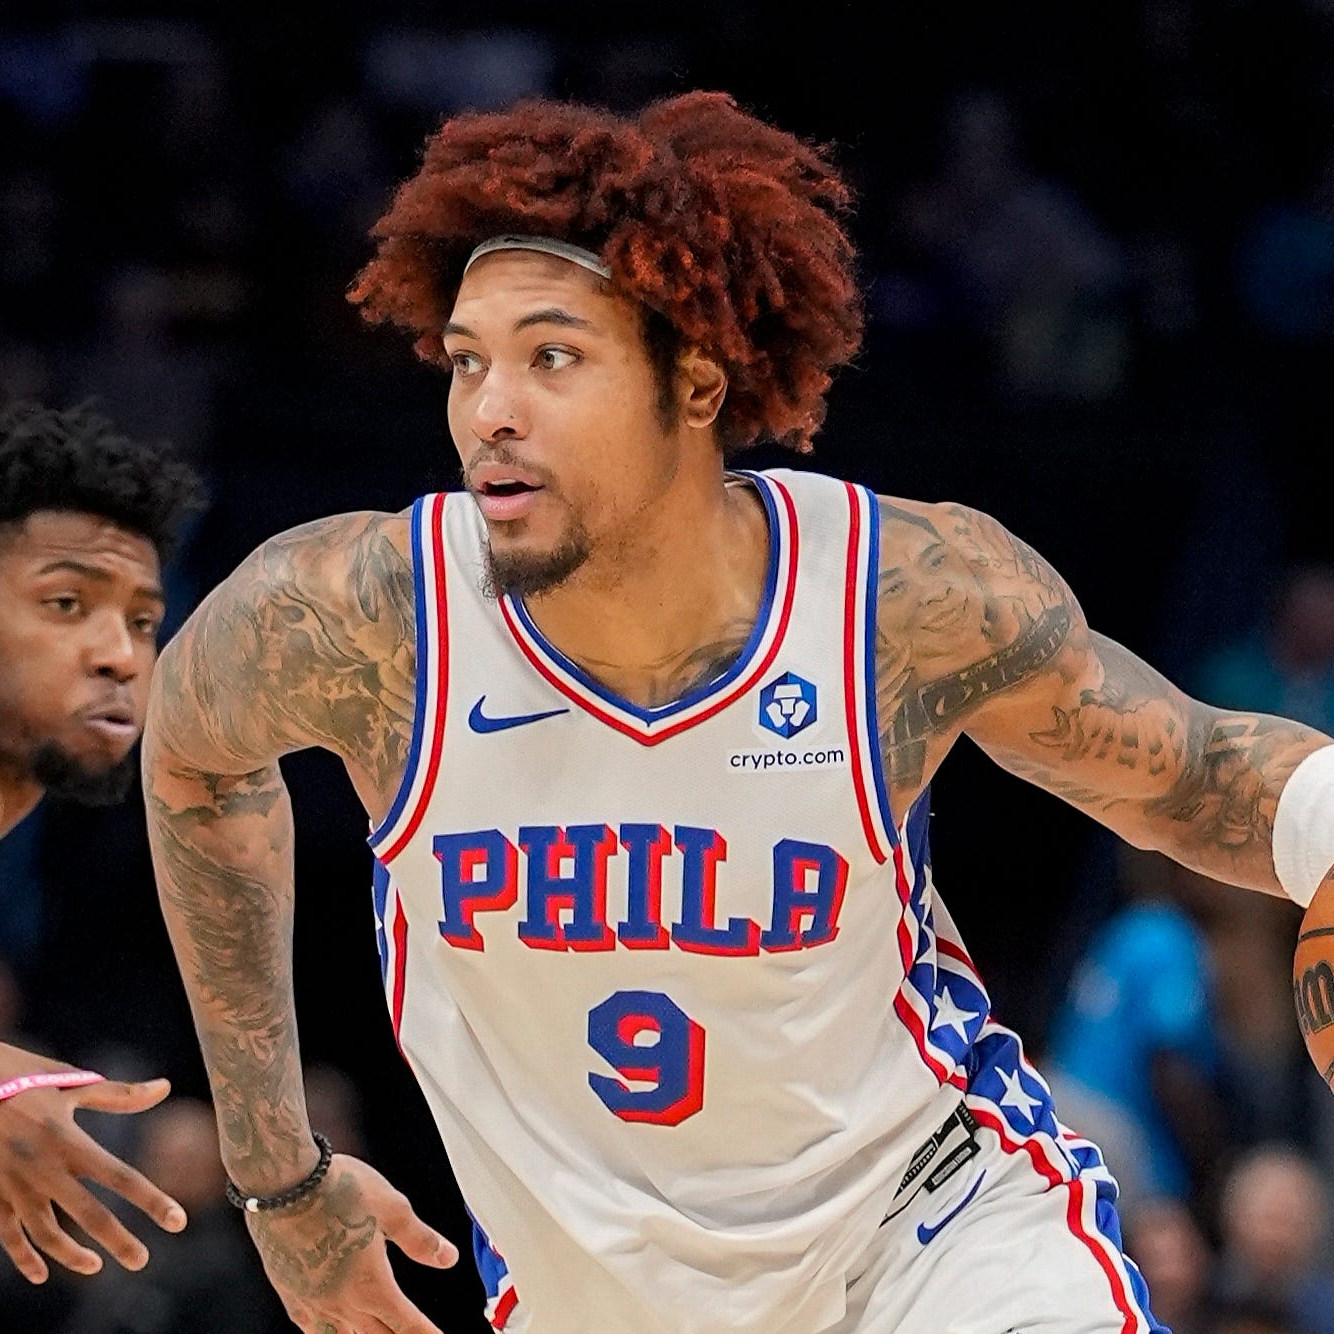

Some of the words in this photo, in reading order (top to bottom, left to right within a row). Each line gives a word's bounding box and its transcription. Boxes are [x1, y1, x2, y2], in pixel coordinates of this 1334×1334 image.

[729, 749, 845, 770] crypto.com
[432, 822, 850, 957] PHILA
[587, 989, 706, 1128] 9
